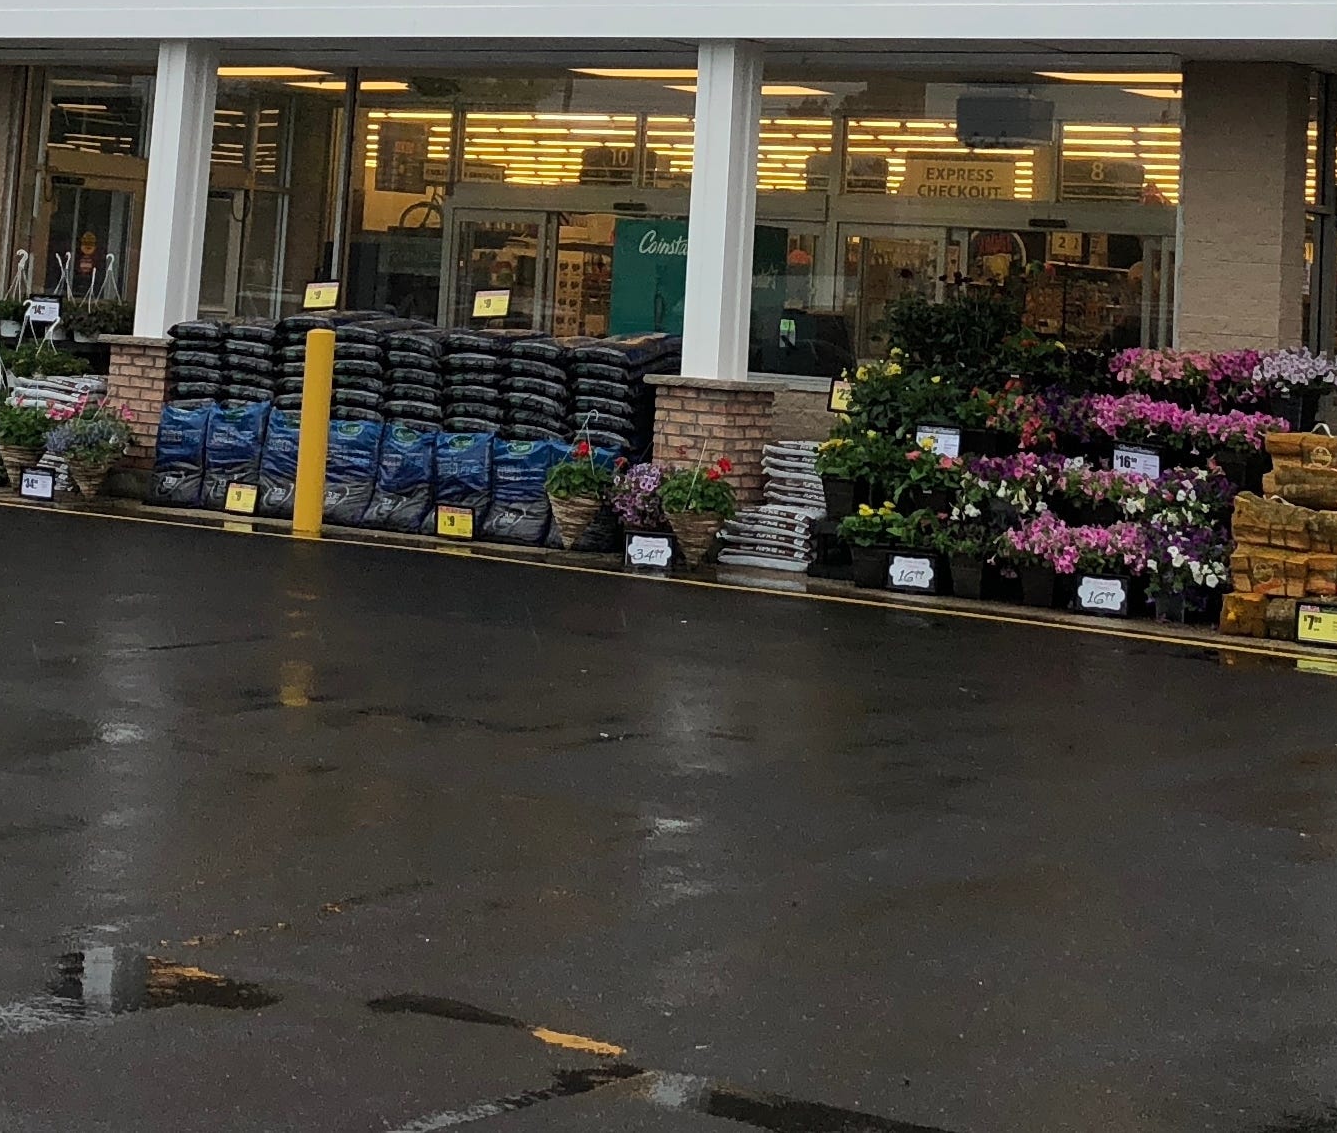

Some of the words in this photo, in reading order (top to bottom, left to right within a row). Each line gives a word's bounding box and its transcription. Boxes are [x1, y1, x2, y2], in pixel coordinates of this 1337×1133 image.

[610, 148, 629, 166] 10
[925, 167, 994, 182] EXPRESS
[1090, 161, 1104, 181] 8
[917, 184, 1002, 199] CHECKOUT
